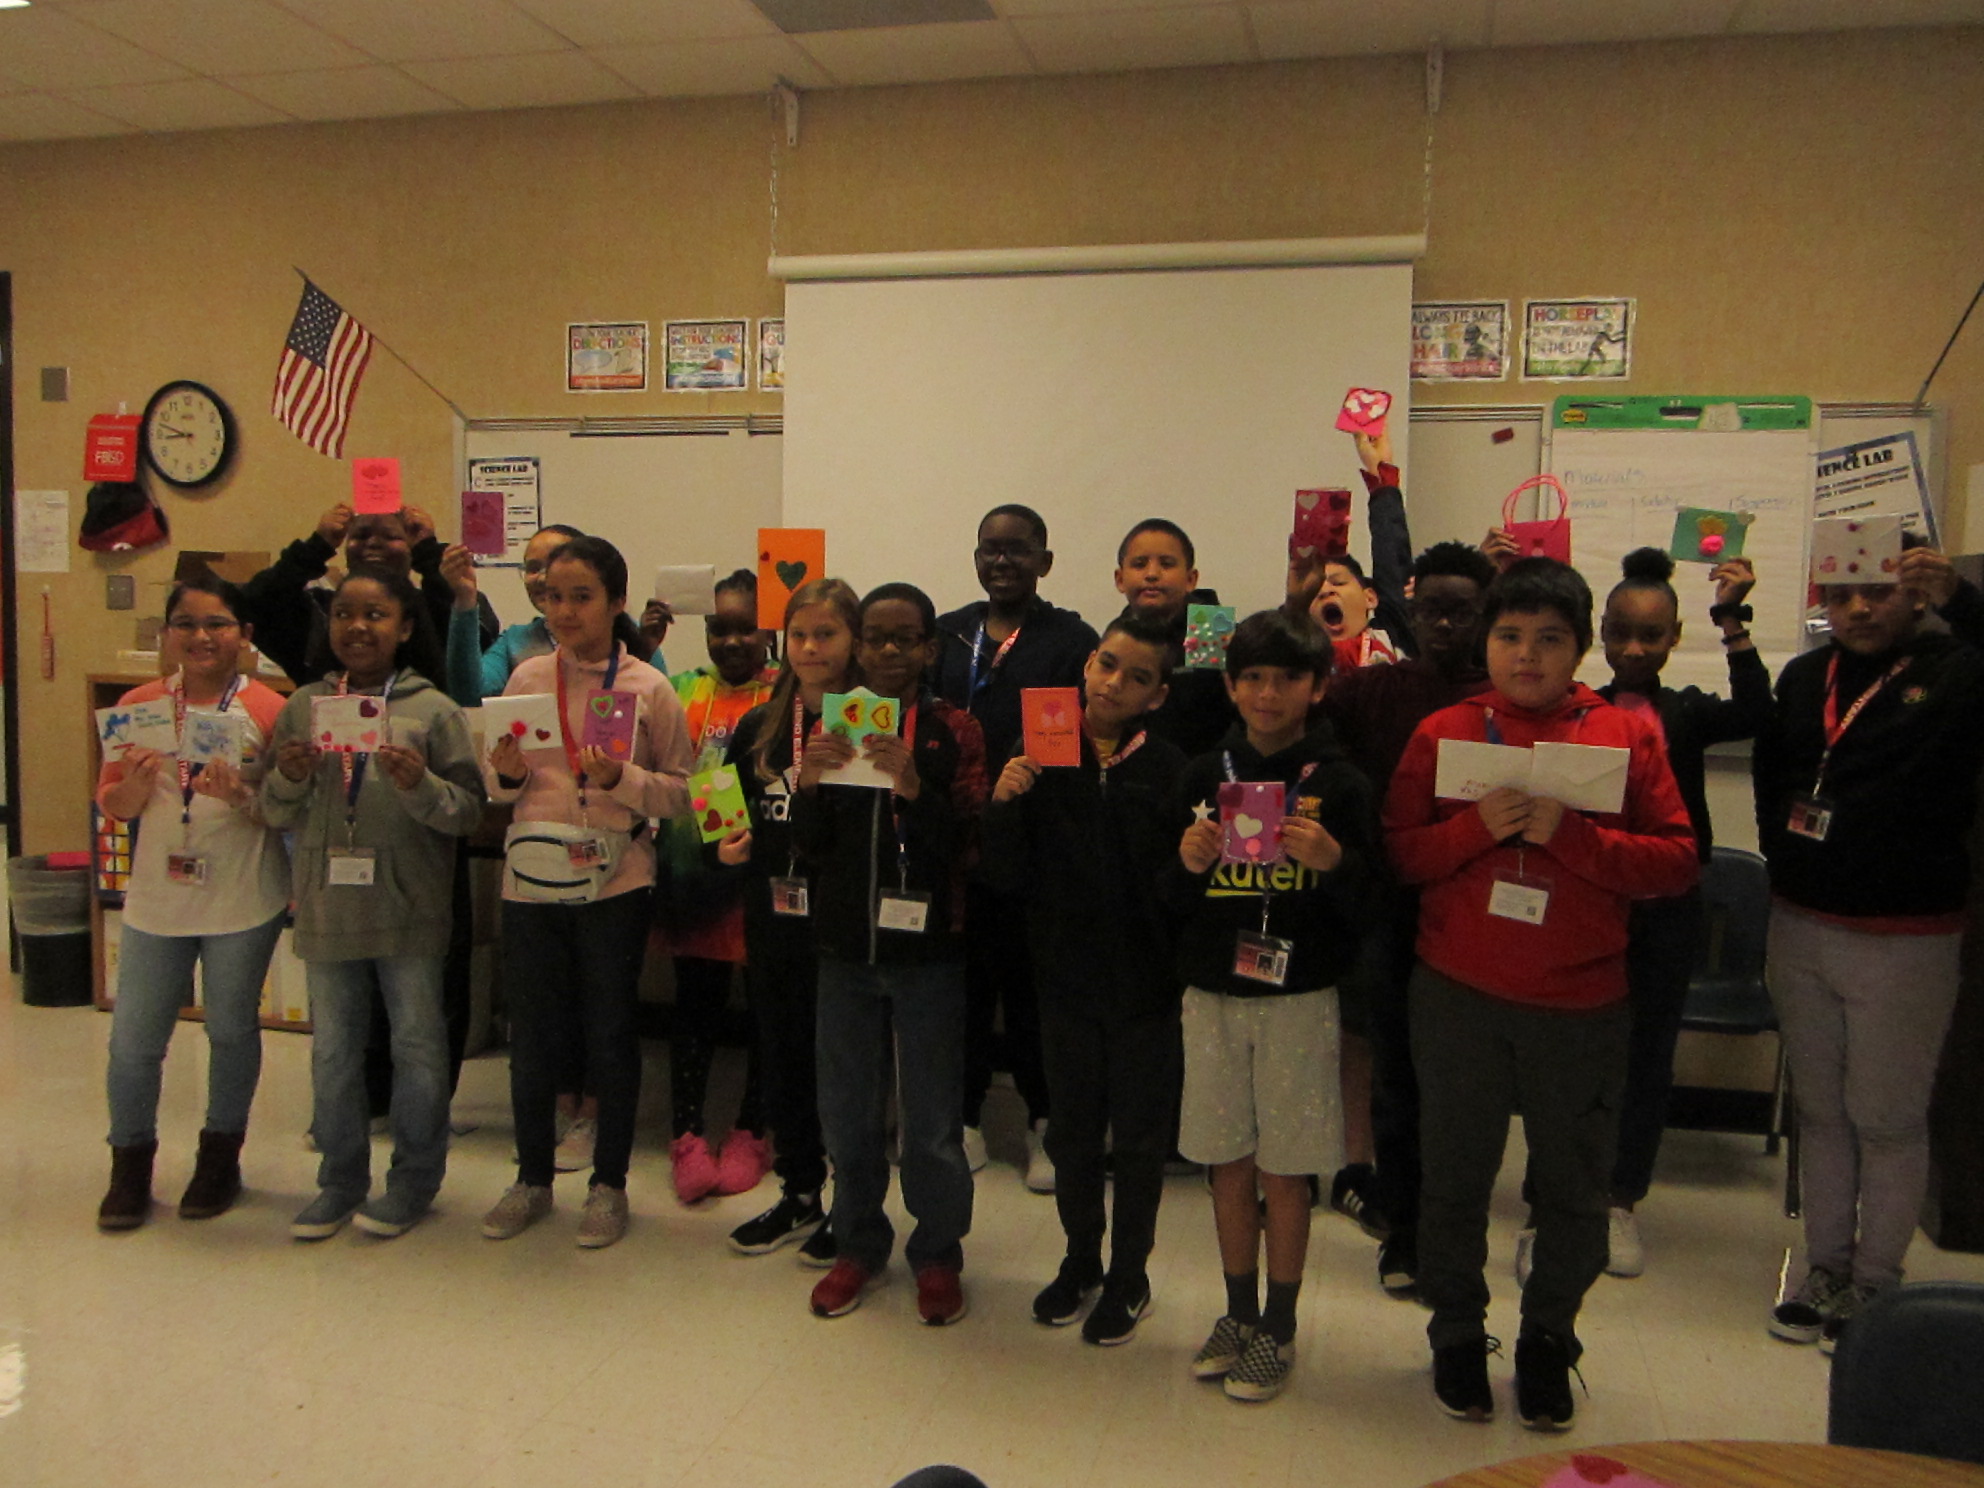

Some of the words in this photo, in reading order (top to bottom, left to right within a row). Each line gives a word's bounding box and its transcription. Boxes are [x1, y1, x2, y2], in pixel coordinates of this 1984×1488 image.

[1818, 457, 1861, 478] IENCE
[1863, 449, 1893, 467] LAB
[1211, 862, 1318, 890] kuten
